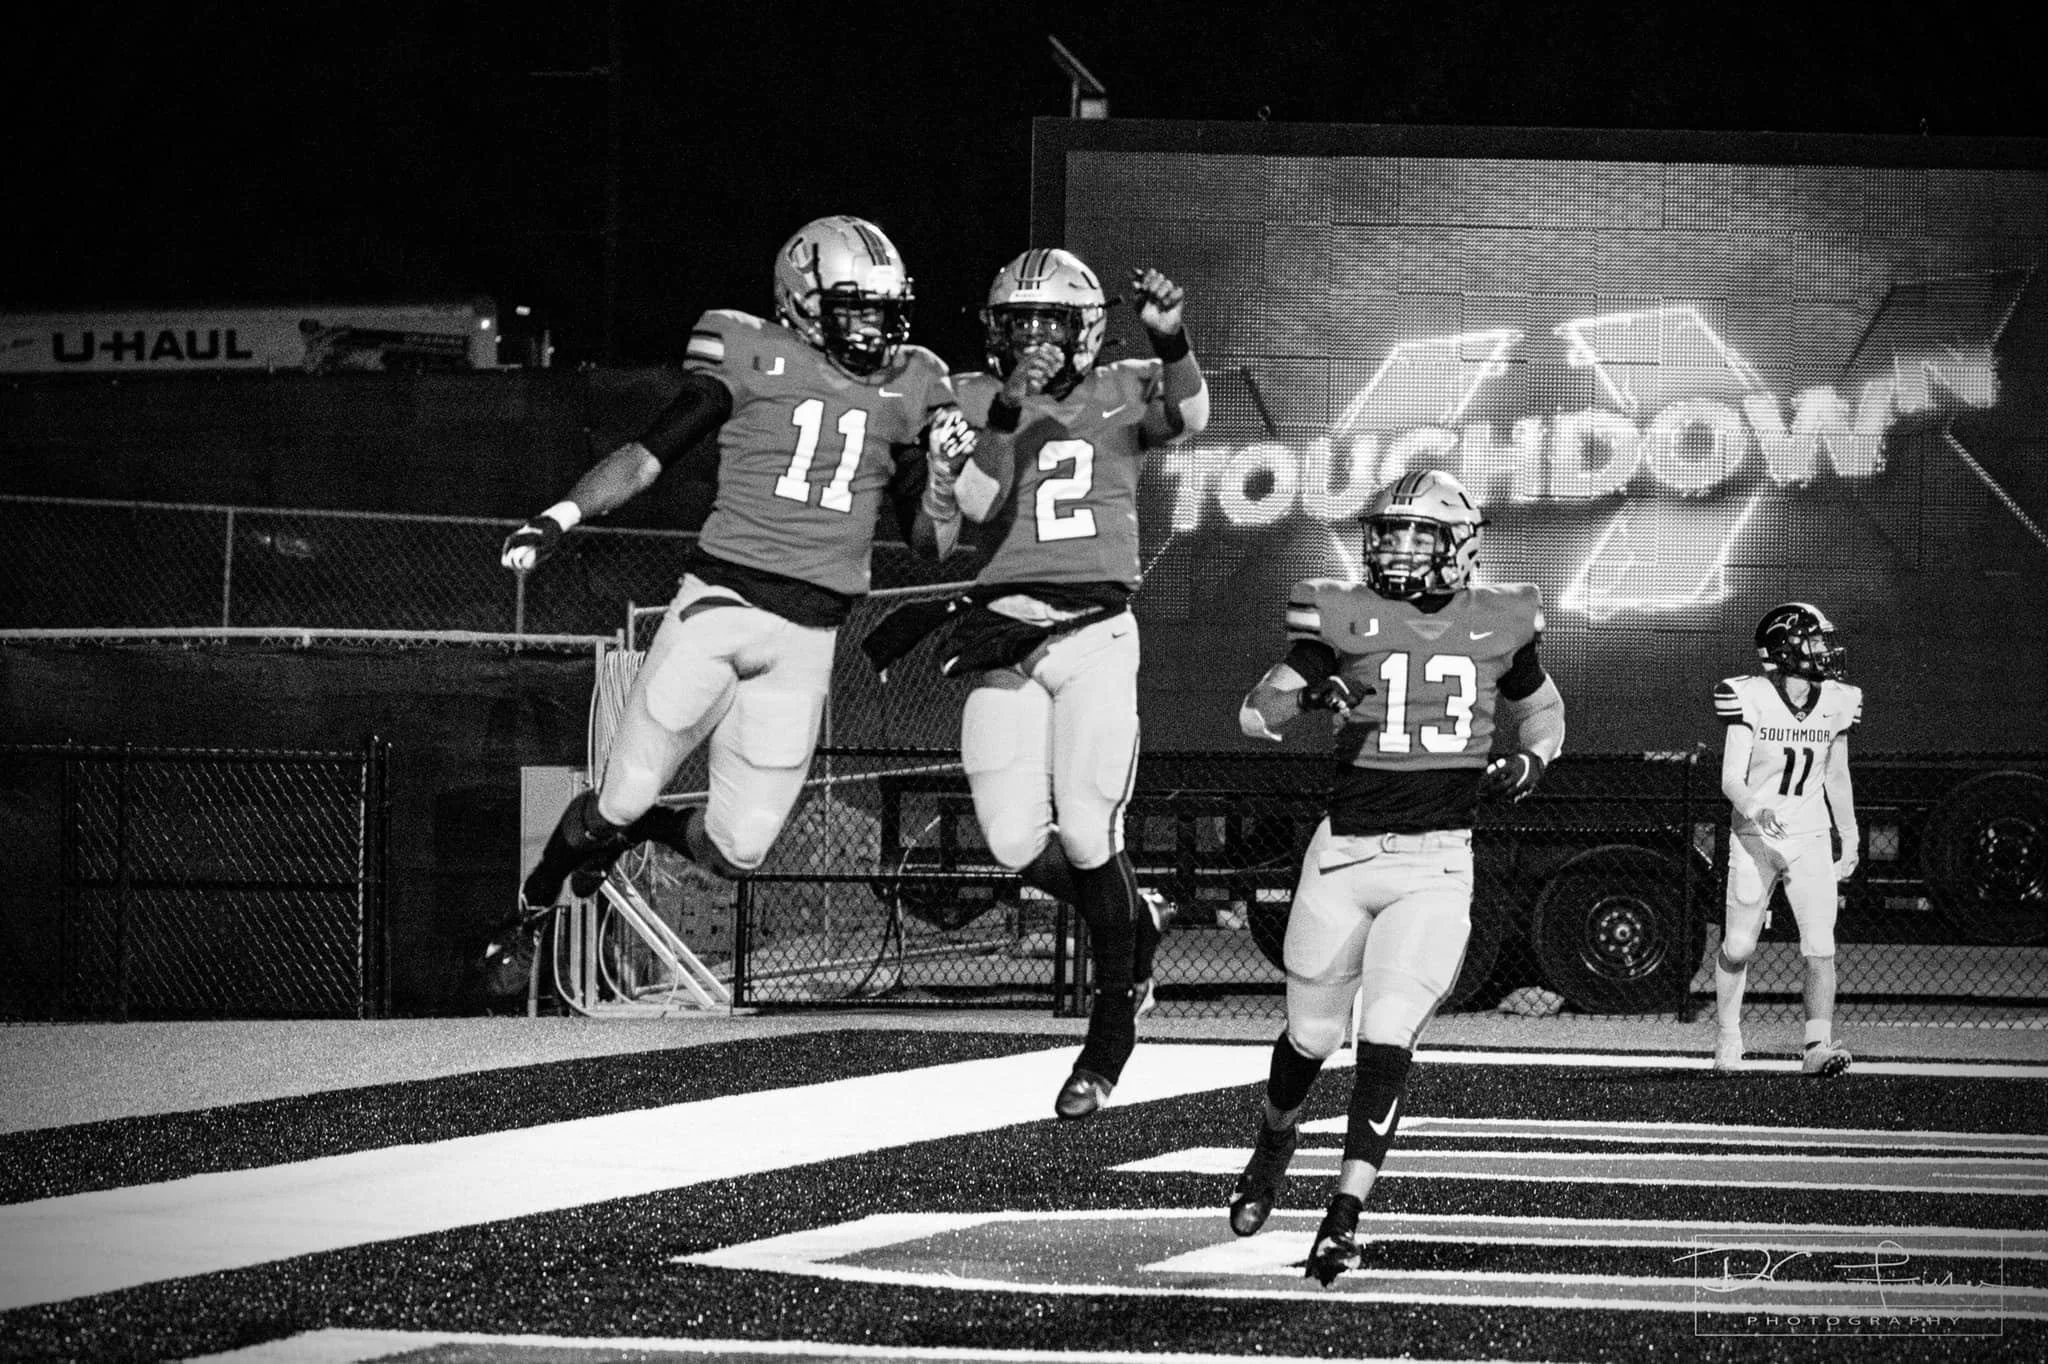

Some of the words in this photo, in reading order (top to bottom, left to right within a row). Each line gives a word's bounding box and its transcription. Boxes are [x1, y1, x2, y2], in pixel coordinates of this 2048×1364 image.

[775, 398, 868, 514] 11
[1163, 347, 2000, 531] TOUCHDOWN
[1036, 439, 1097, 542] 2
[1378, 652, 1477, 753] 13
[1760, 727, 1831, 743] SOUTHMOOR
[1778, 746, 1814, 796] 11
